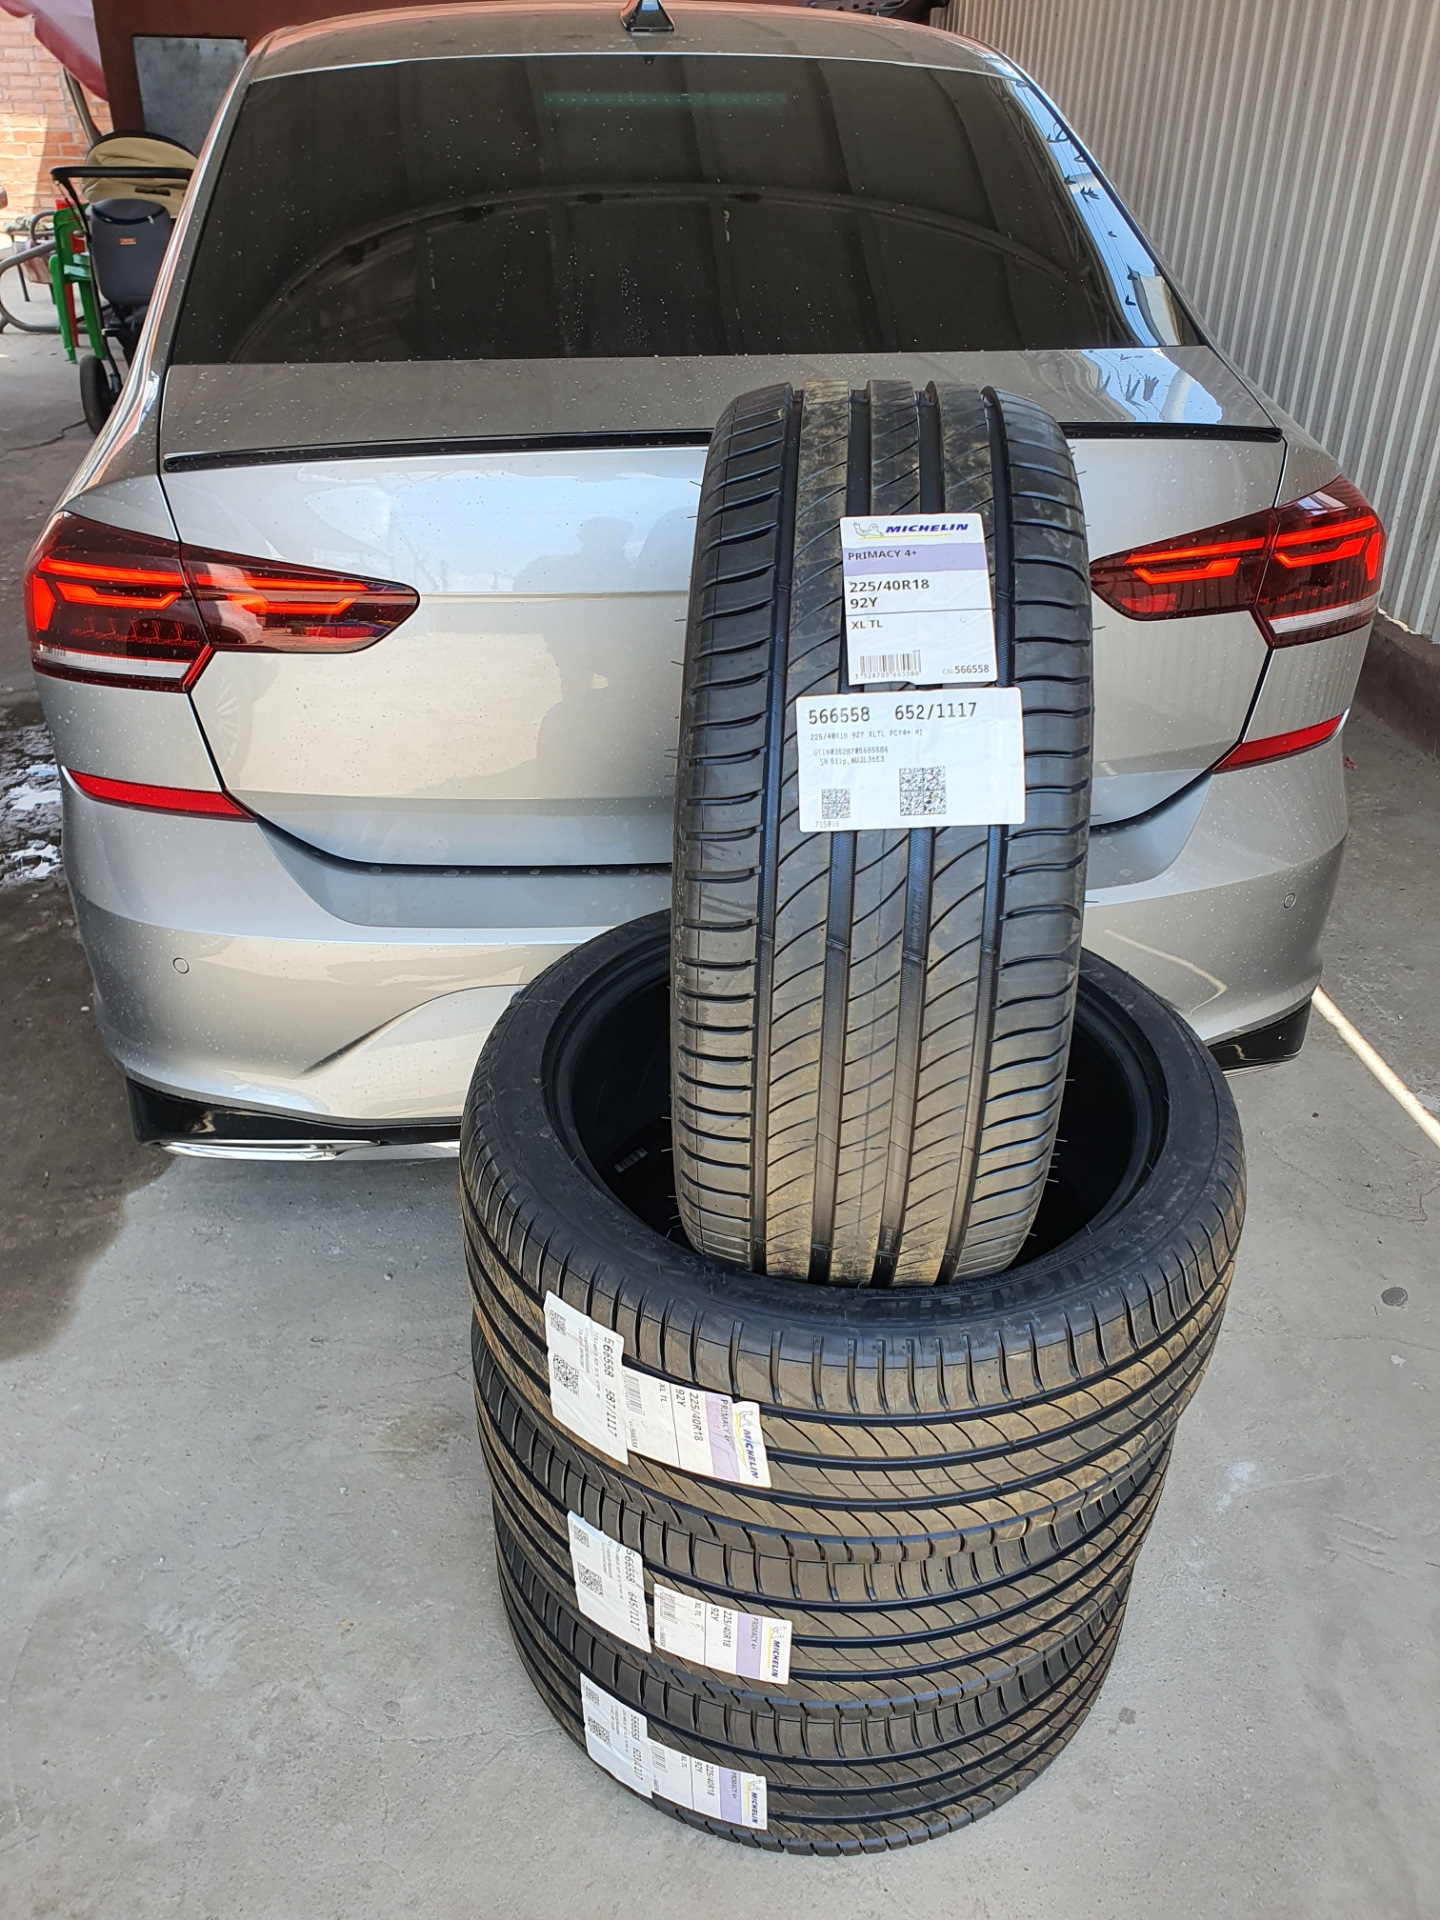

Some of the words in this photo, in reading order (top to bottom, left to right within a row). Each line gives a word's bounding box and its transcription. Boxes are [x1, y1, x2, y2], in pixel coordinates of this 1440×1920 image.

[885, 524, 969, 533] MICHELIN
[848, 550, 901, 560] PRIMACY
[850, 579, 929, 592] 225/40R18
[850, 597, 878, 608] 92Y
[851, 621, 866, 629] XL
[871, 620, 883, 628] TL
[955, 665, 989, 674] 566558
[808, 707, 870, 724] 566558
[895, 702, 977, 720] 652/1117
[810, 733, 848, 741] 225/40R18
[852, 731, 864, 739] 92Y
[603, 1337, 614, 1378] 566558
[659, 1383, 667, 1392] XL
[660, 1394, 667, 1402] TL
[676, 1389, 686, 1407] 92Y
[690, 1393, 703, 1441] 225/40R18
[721, 1399, 729, 1433] PRIMACY
[743, 1429, 759, 1479] MICHELIN
[624, 1549, 635, 1583] 566558
[710, 1607, 719, 1622] 92Y
[723, 1610, 732, 1647] 225/40R18
[771, 1640, 780, 1678] MICHELIN
